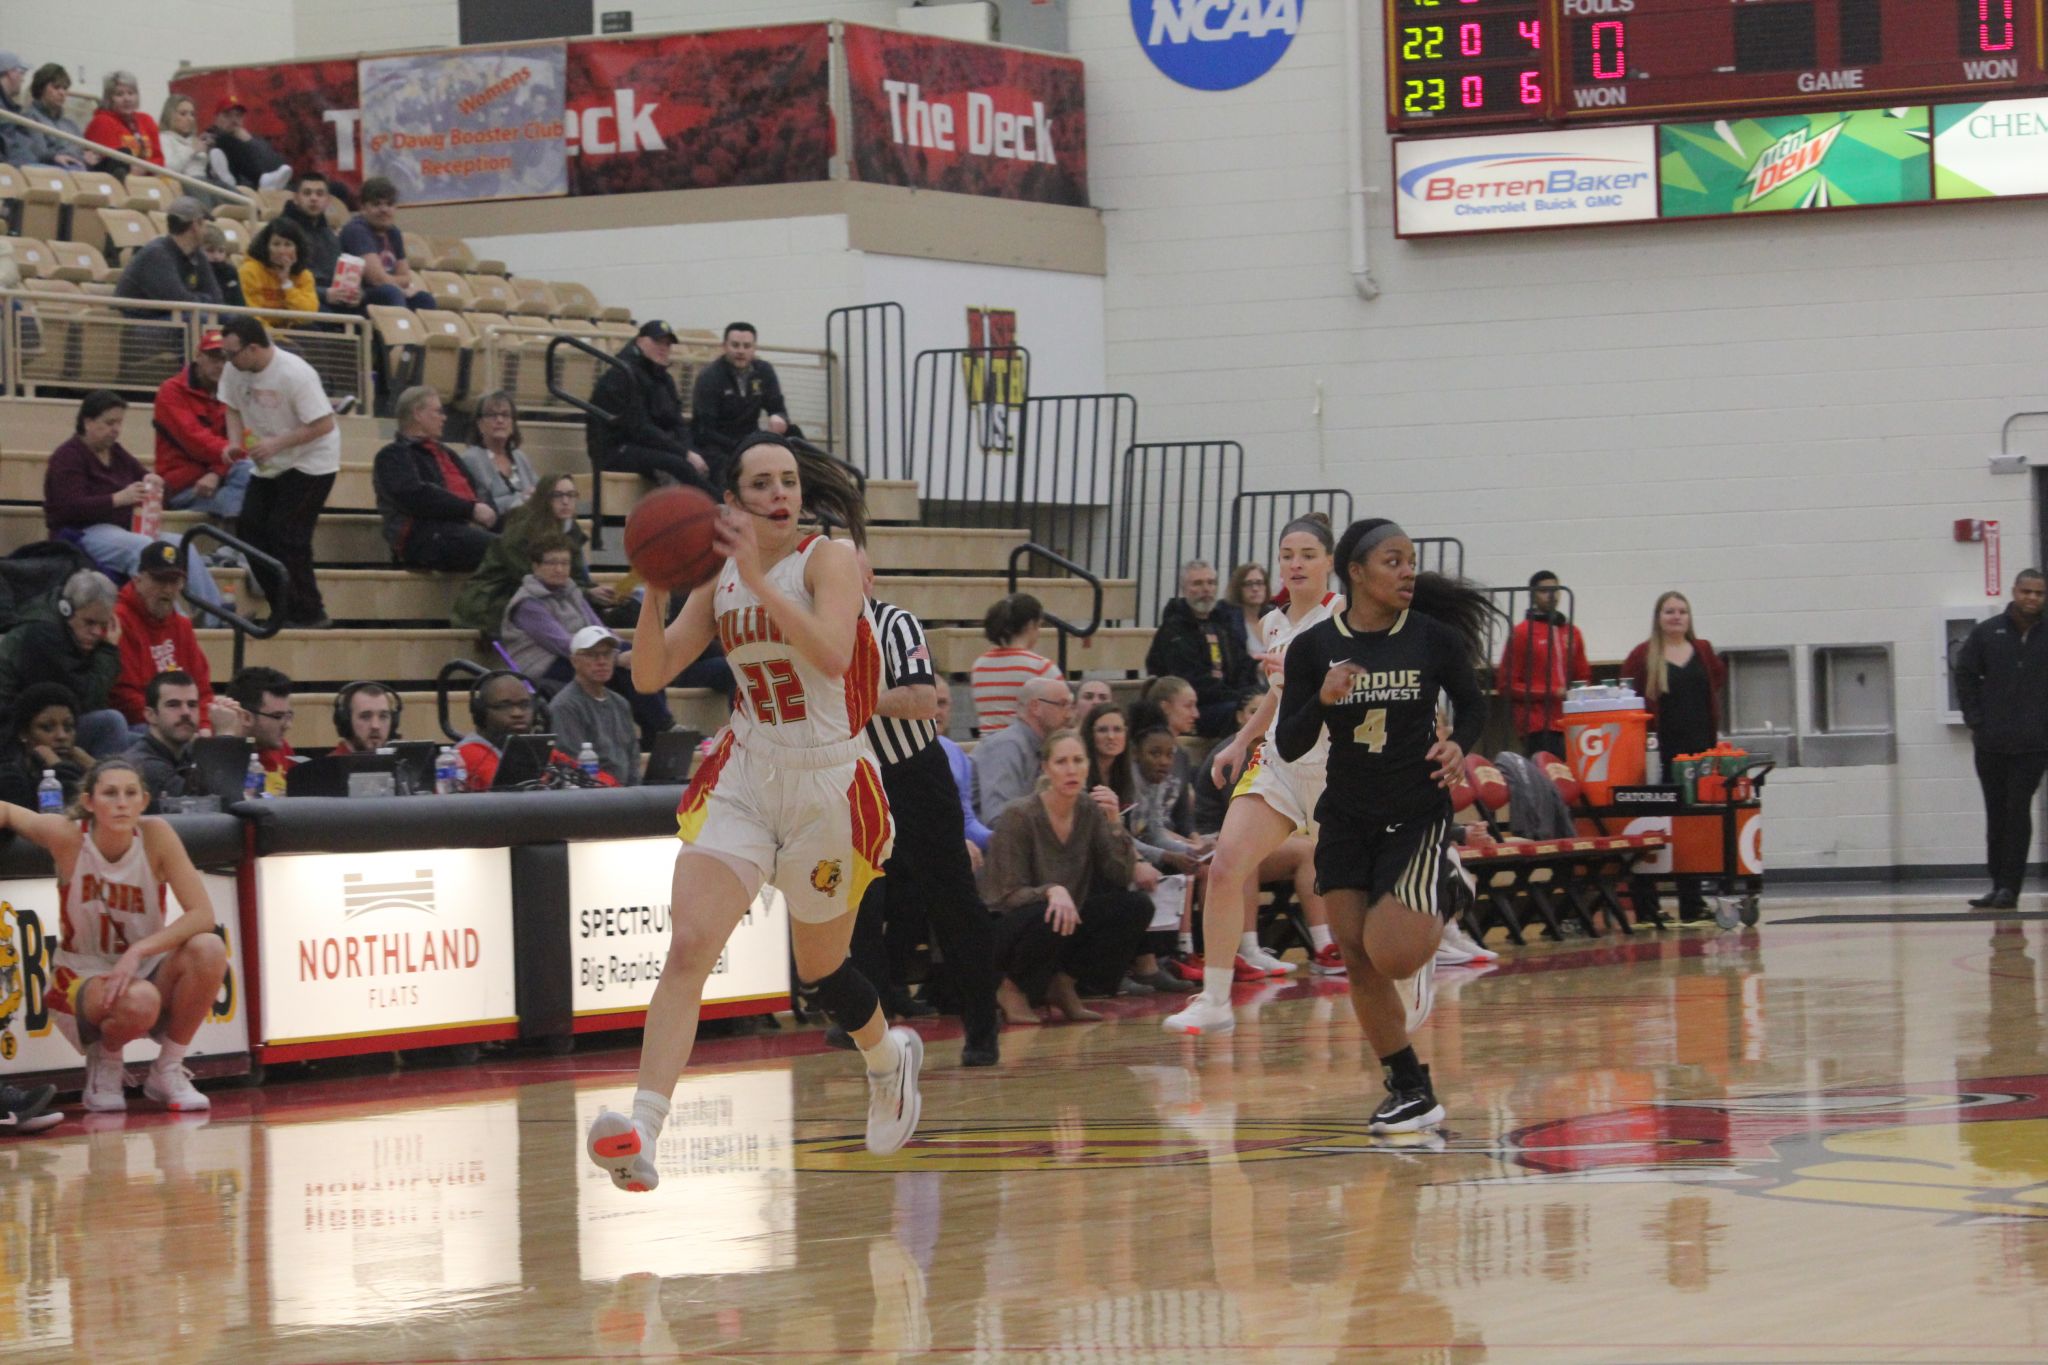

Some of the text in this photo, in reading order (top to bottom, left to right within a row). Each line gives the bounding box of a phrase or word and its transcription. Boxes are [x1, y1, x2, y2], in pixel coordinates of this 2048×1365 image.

[1564, 0, 1634, 15] FOULS
[1148, 0, 1297, 46] NCAA
[1403, 20, 1540, 59] 22 0 4
[1592, 21, 1625, 79] 0
[1797, 69, 1864, 92] GAME
[1963, 59, 2018, 81] WON
[458, 67, 531, 117] Womens
[1404, 72, 1541, 112] 23 0 6
[1574, 87, 1627, 107] WON
[393, 132, 445, 151] Dawg
[451, 128, 518, 146] Booster
[524, 121, 564, 140] Club
[883, 80, 1057, 165] The Deck
[420, 155, 512, 176] Reception
[1455, 194, 1623, 216] Chevrolet Buick GMC
[739, 658, 807, 726] 22
[1349, 670, 1421, 691] RDUE
[1354, 708, 1388, 753] 4
[1579, 728, 1605, 756] G
[1616, 792, 1678, 803] GATORADE
[299, 927, 481, 982] NORTHLAND
[581, 952, 662, 991] Big Rapids
[369, 985, 419, 1009] FLATS
